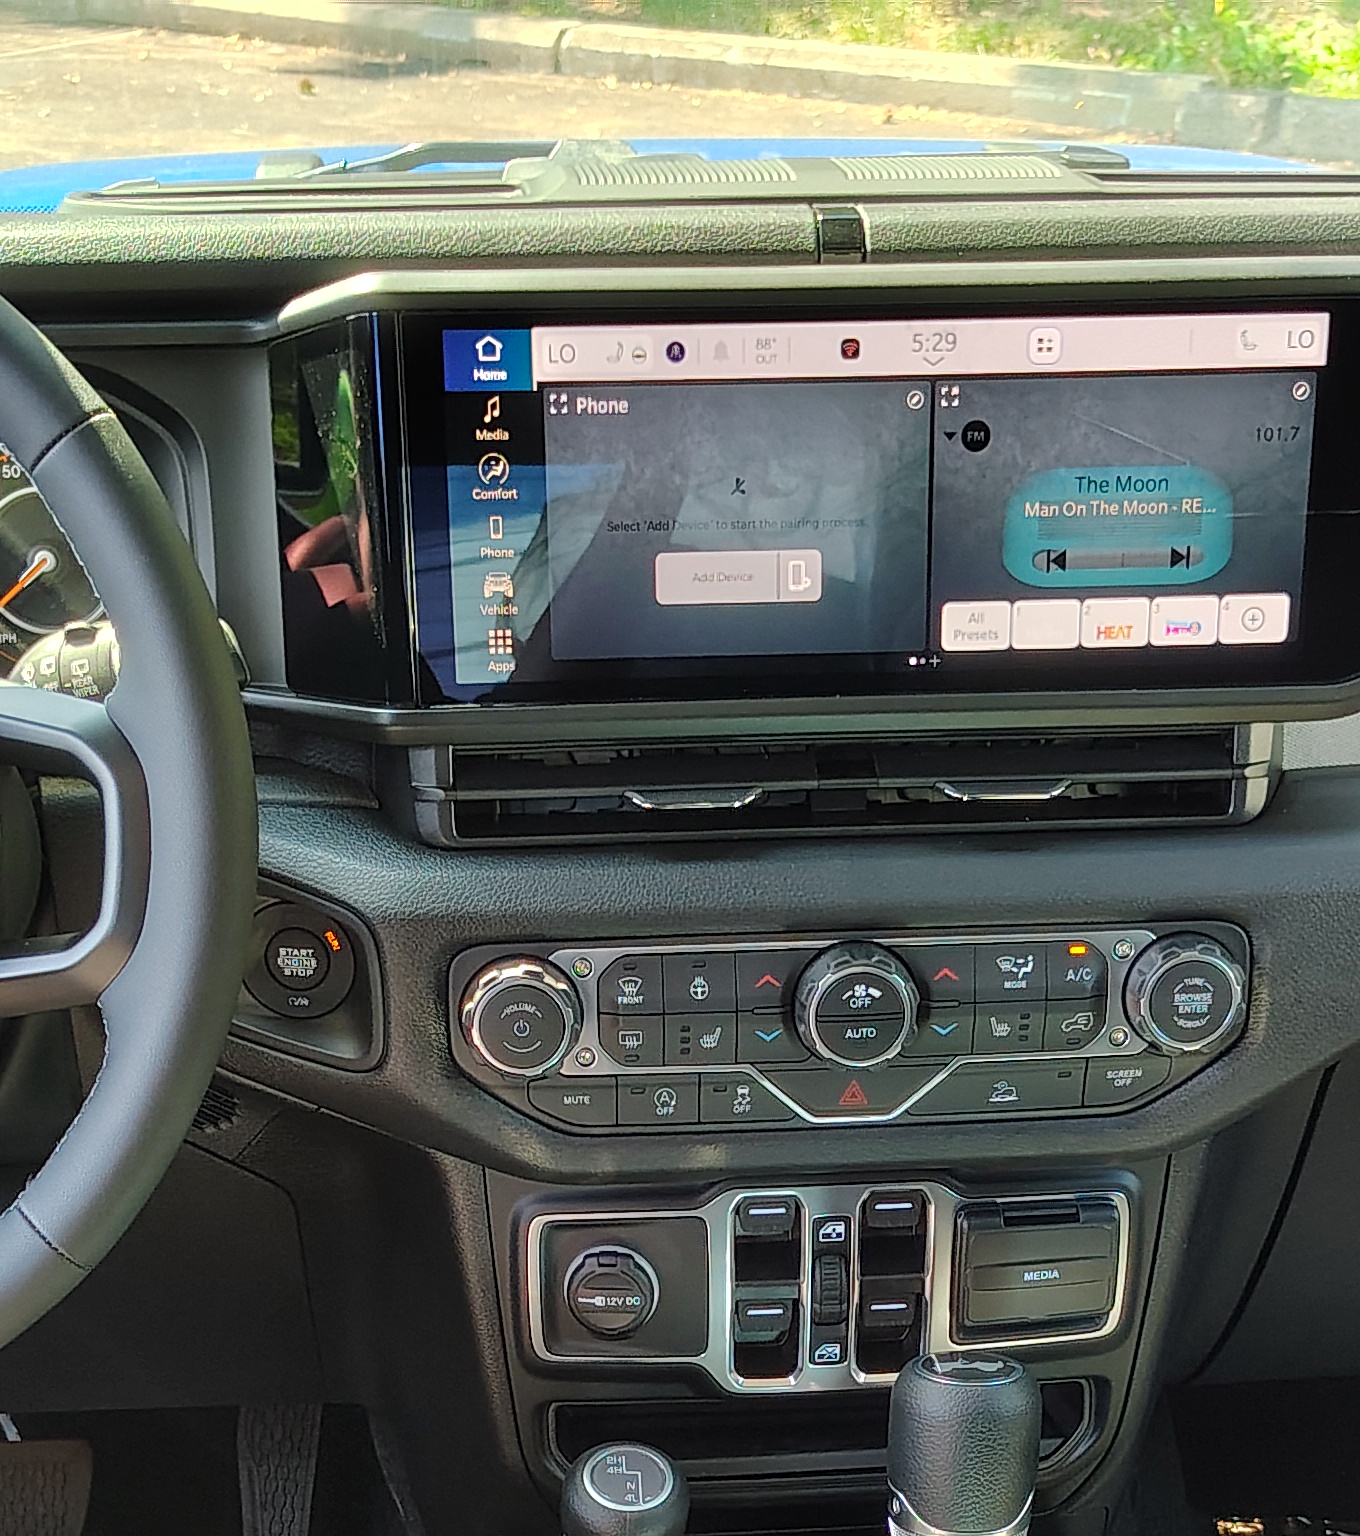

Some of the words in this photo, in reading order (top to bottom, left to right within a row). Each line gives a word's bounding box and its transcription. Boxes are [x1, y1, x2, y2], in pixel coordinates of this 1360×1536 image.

[911, 333, 958, 354] 5:29
[1286, 329, 1315, 350] LO
[548, 343, 577, 365] LO
[473, 368, 508, 382] Home
[575, 397, 630, 416] Phone
[475, 428, 510, 442] Media
[966, 430, 985, 442] FM
[1255, 425, 1301, 443] 101.7
[1, 464, 22, 480] 50
[1074, 475, 1110, 494] The
[1115, 475, 1170, 493] Moon
[472, 487, 519, 501] Comfort
[1024, 502, 1060, 518] Man
[1063, 502, 1088, 517] On
[1090, 500, 1120, 516] The
[1123, 499, 1169, 515] Moon
[606, 520, 641, 532] Select
[716, 520, 729, 530] to
[730, 520, 757, 530] start
[759, 519, 779, 529] the
[780, 518, 820, 532] pairing
[480, 546, 516, 559] Phone
[480, 603, 520, 617] Vehicle
[1083, 605, 1091, 616] 2
[1153, 604, 1161, 614] 3
[967, 612, 985, 625] All
[1096, 624, 1135, 641] HEAT
[488, 660, 516, 674] Apps
[279, 947, 315, 957] START
[277, 958, 318, 968] ENGINE
[283, 968, 314, 977] STOP
[1065, 967, 1093, 982] A/C
[1003, 980, 1027, 989] MODE
[617, 995, 645, 1005] FRONT
[849, 998, 873, 1009] OFF
[1174, 993, 1213, 1002] BROWSE
[503, 1002, 537, 1016] VOLUME
[1178, 1005, 1208, 1014] ENTER
[844, 1027, 877, 1039] AUTO
[1106, 1069, 1143, 1079] SCREEN
[1113, 1078, 1132, 1087] OFF
[563, 1095, 591, 1105] MUTE
[656, 1106, 675, 1116] OFF
[733, 1104, 752, 1115] OFF
[1023, 1268, 1060, 1282] MEDIA
[606, 1296, 625, 1306] 12V
[626, 1481, 636, 1490] N
